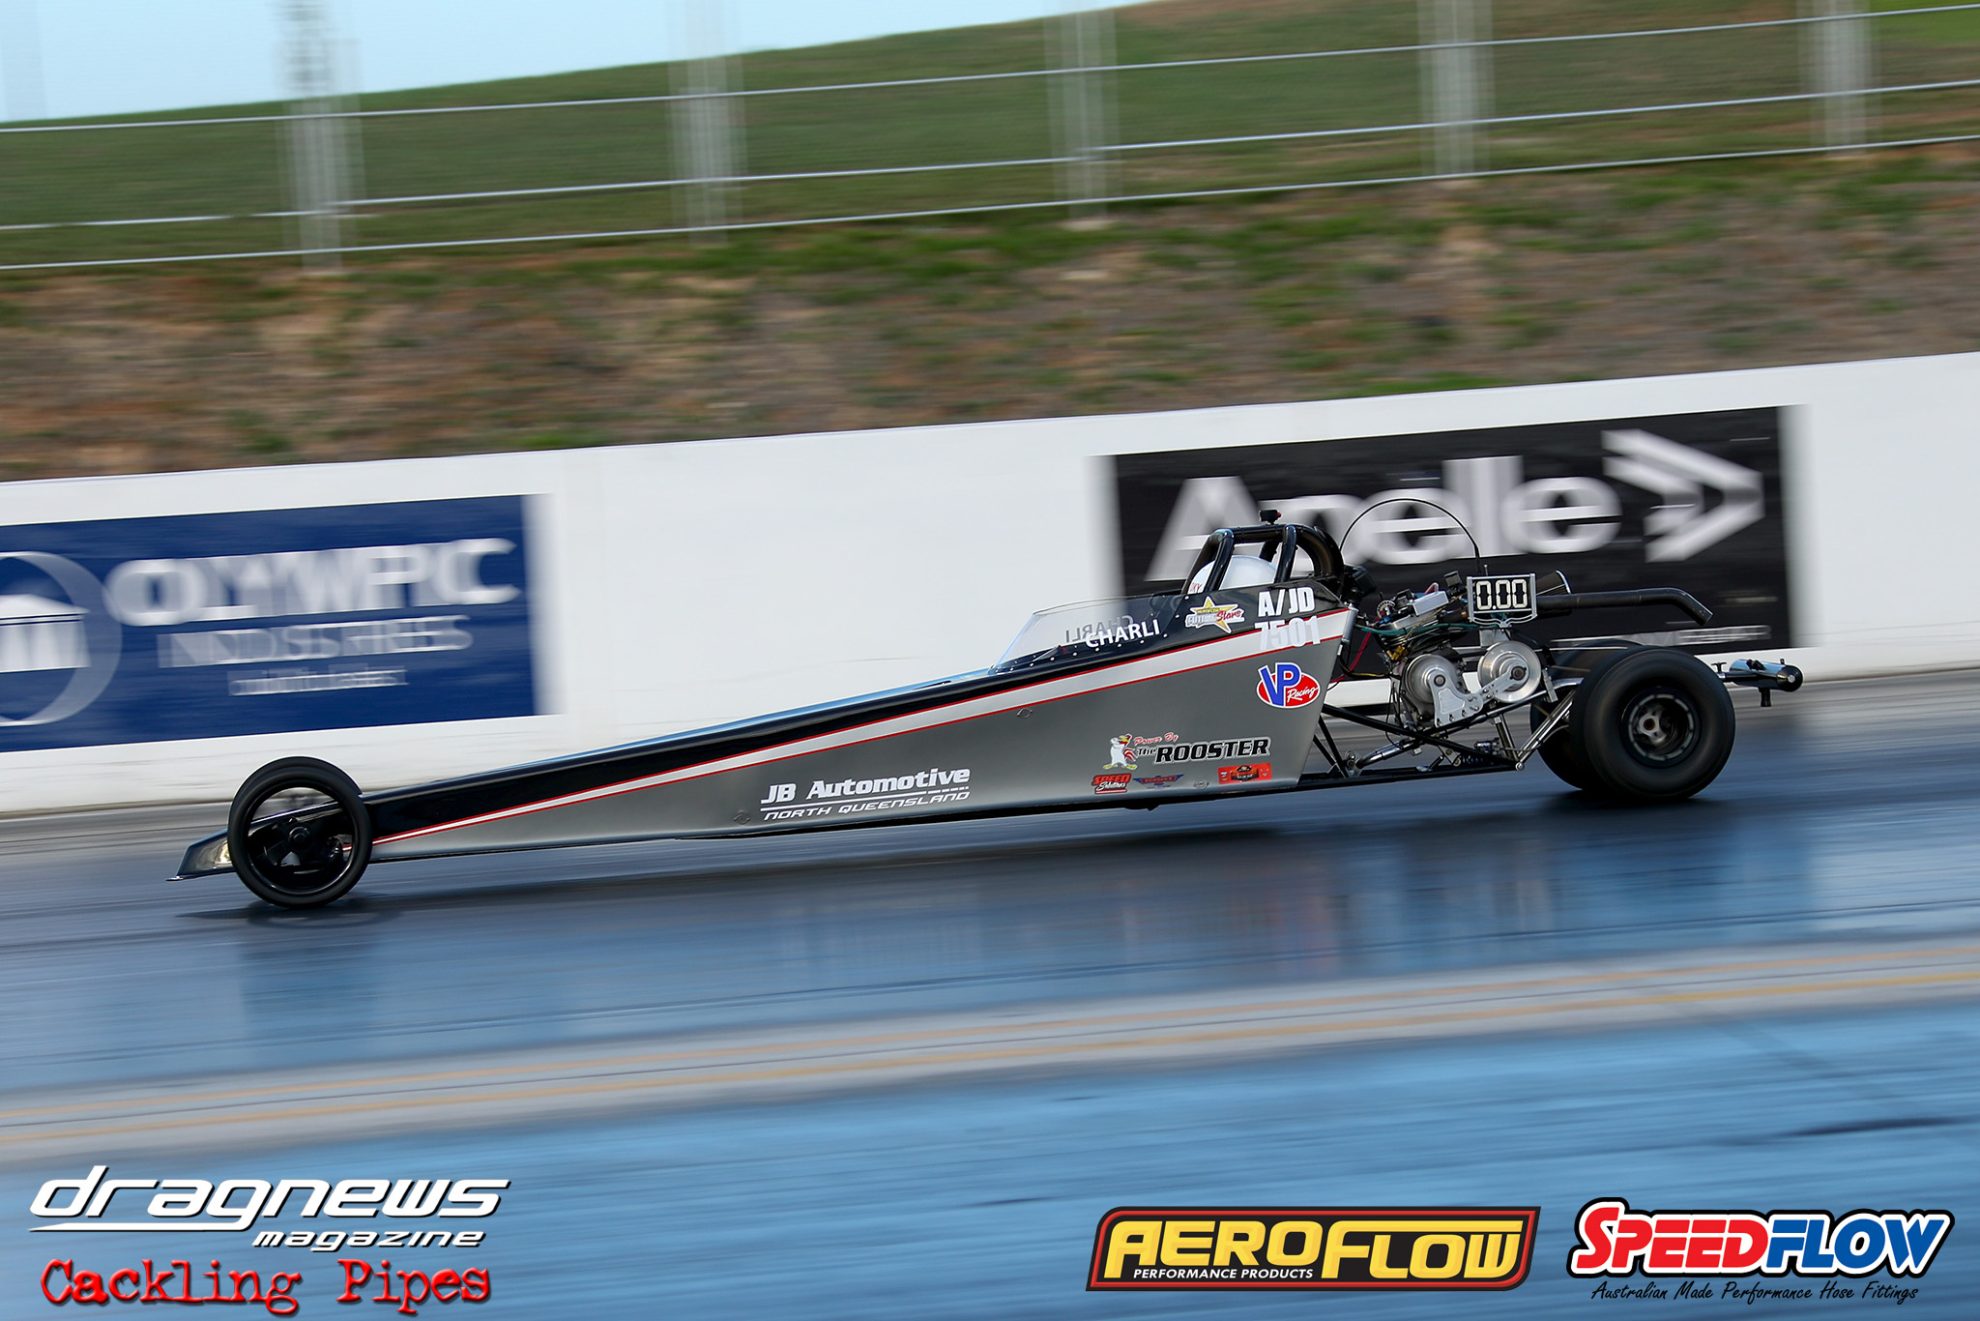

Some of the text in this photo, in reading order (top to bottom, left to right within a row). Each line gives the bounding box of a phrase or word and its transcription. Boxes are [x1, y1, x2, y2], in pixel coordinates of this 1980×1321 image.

[1258, 587, 1315, 617] A/JD
[1476, 579, 1527, 610] 0.00
[1085, 619, 1160, 648] CHARLI
[1254, 615, 1321, 650] 7501
[1258, 662, 1302, 706] VP
[1287, 686, 1319, 703] Racing
[1154, 737, 1271, 764] ROOSTER
[761, 768, 970, 804] JB Automotive
[764, 792, 970, 820] NORTH QUEENSLAND
